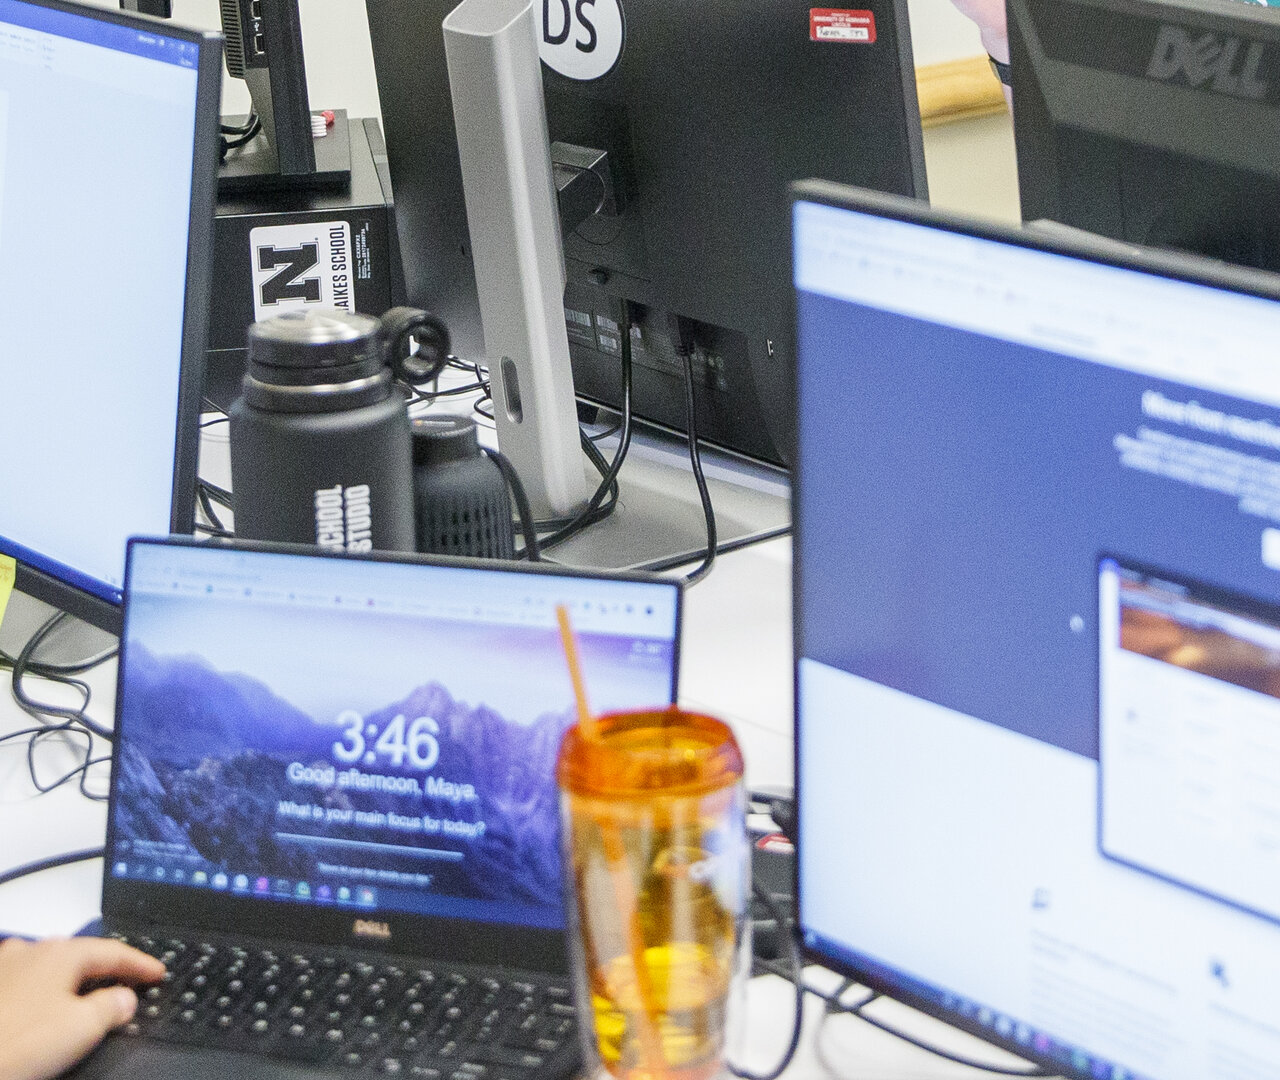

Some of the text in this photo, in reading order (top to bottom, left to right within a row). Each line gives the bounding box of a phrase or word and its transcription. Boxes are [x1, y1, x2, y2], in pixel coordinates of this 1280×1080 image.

[1145, 22, 1270, 99] DELL
[256, 241, 322, 308] N
[329, 224, 350, 311] AIKES SCHOOL
[345, 484, 373, 554] STUDIO
[286, 761, 336, 786] Good
[332, 710, 441, 771] 3:46
[277, 800, 312, 818] What
[325, 808, 353, 824] your
[354, 810, 387, 826] main
[387, 811, 421, 829] focus
[422, 815, 441, 832] for
